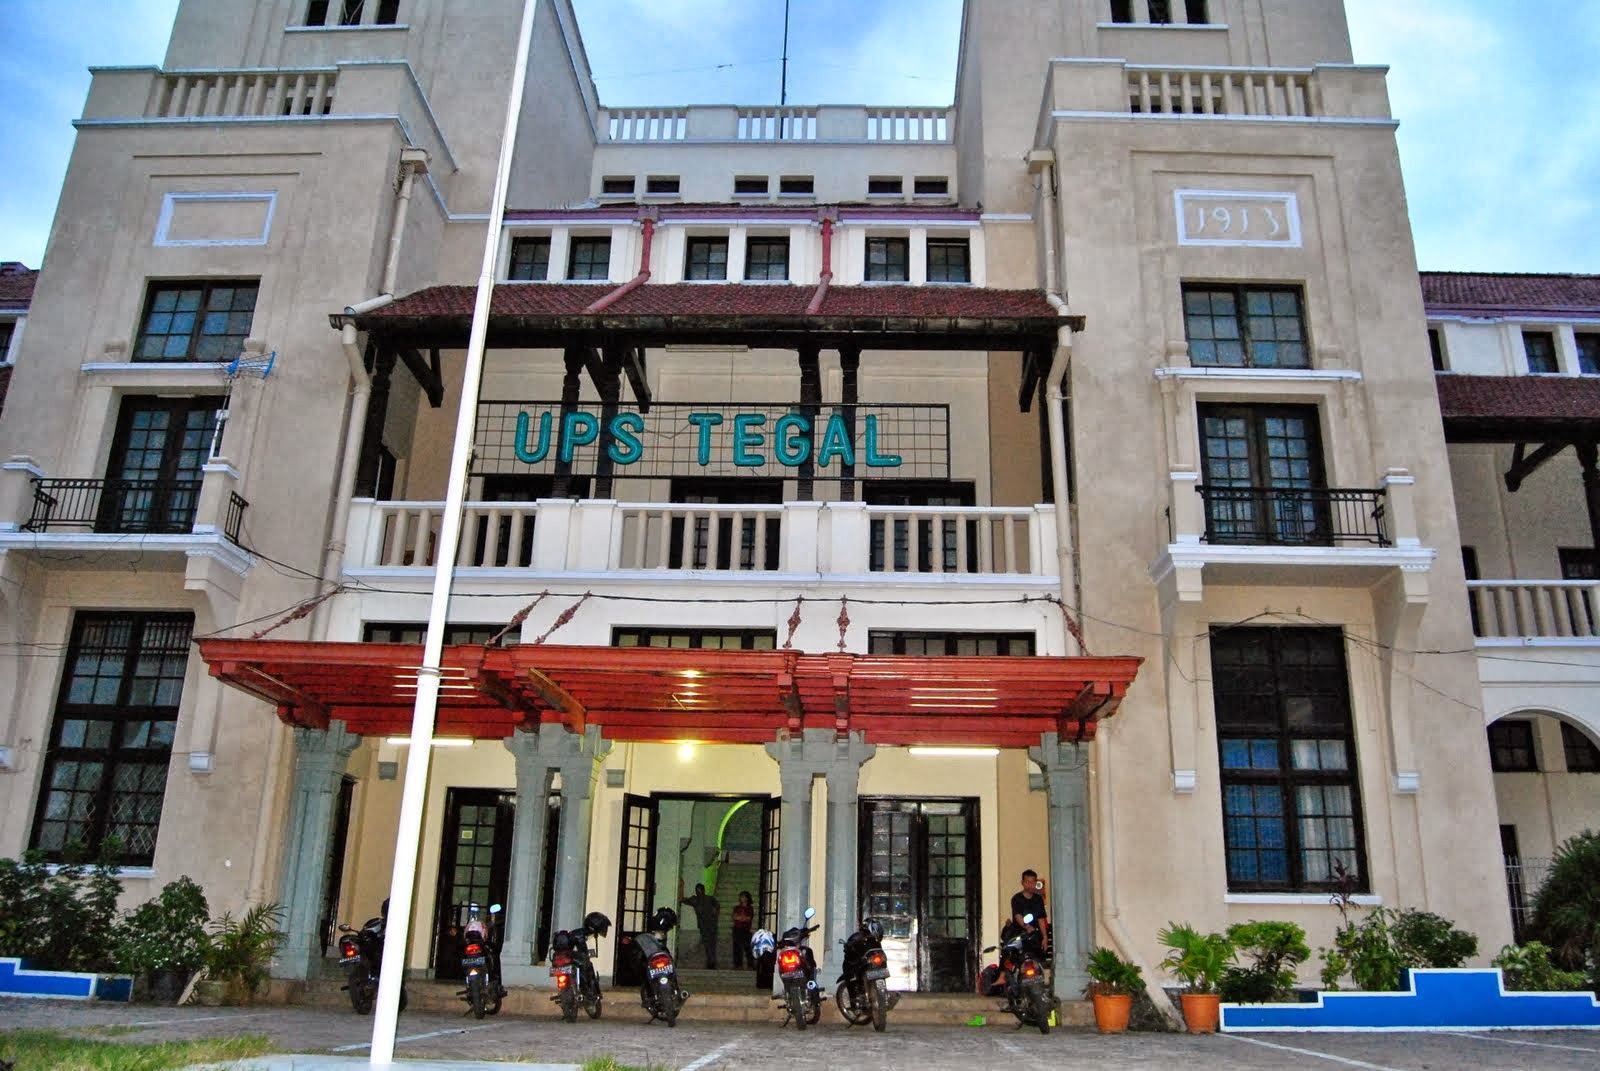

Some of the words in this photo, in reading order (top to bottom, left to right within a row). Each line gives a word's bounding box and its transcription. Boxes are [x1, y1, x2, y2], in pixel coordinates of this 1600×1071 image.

[1197, 206, 1280, 236] 1913
[514, 411, 644, 464] UPS
[688, 413, 903, 467] TEGAL
